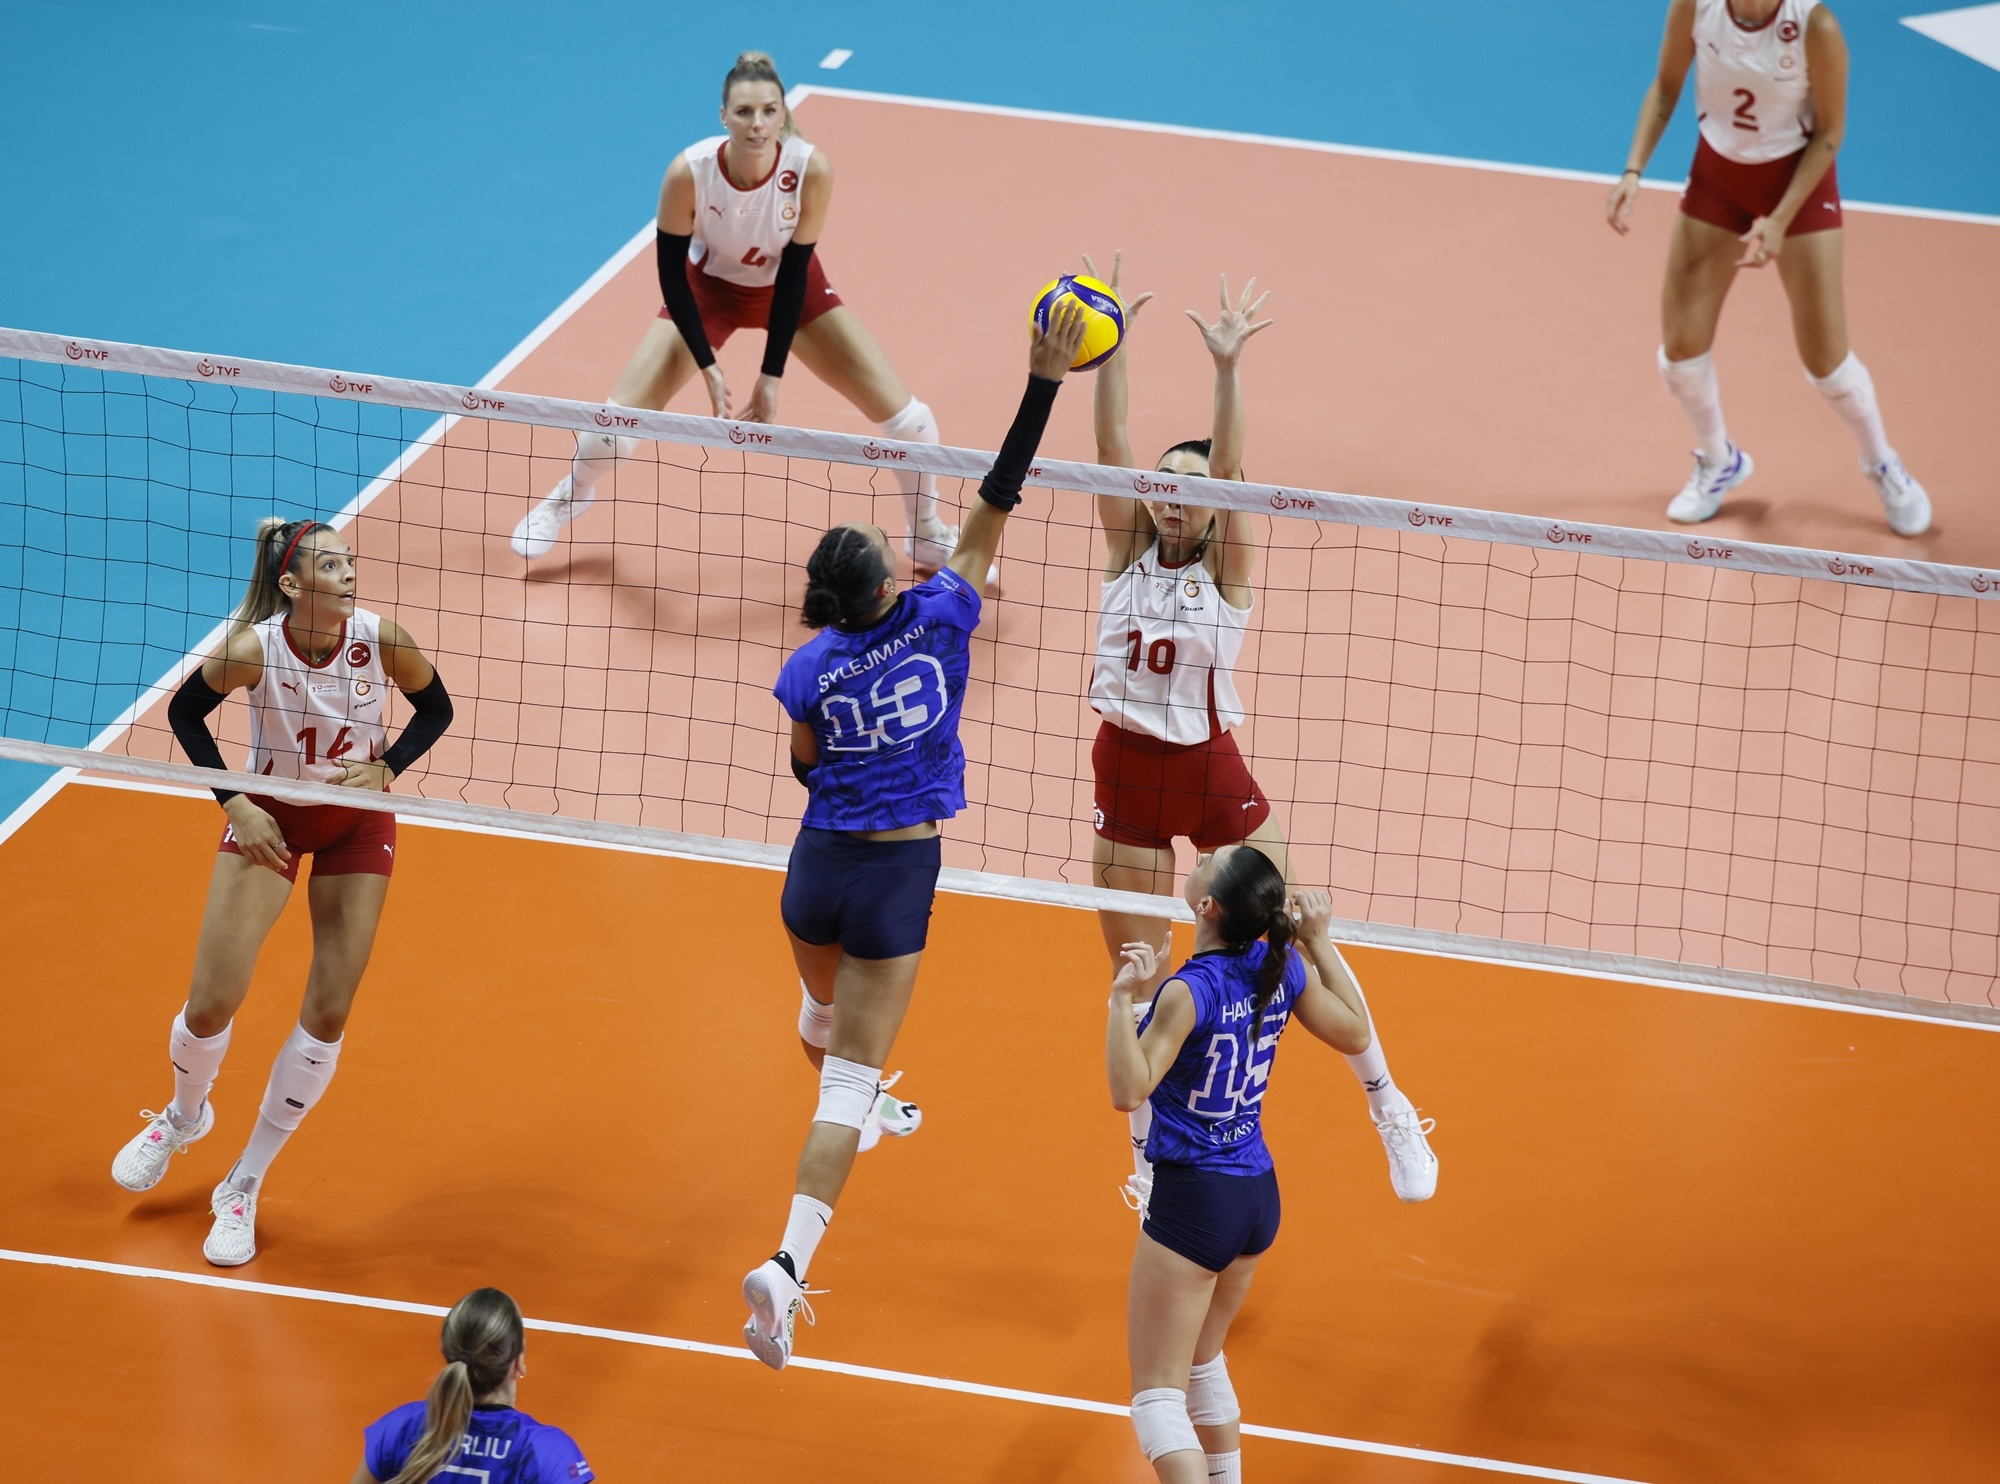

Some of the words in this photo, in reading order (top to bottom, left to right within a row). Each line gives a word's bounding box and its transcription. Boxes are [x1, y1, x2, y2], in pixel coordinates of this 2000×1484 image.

[1733, 88, 1756, 121] 2
[740, 247, 767, 267] 4
[85, 349, 109, 360] TVF
[217, 365, 240, 377] TVF
[348, 382, 372, 393] TVF
[481, 399, 505, 410] TVF
[614, 416, 638, 428] TVF
[748, 433, 772, 444] TVF
[882, 449, 907, 460] TVF
[1026, 468, 1042, 478] VF
[1153, 482, 1178, 494] TVF
[1290, 499, 1315, 510] TVF
[1428, 515, 1453, 527] TVF
[1567, 532, 1592, 543] TVF
[1707, 547, 1733, 559] TVF
[1848, 564, 1874, 576] TVF
[1127, 630, 1176, 674] 10
[817, 625, 925, 693] SYLEJMANI
[821, 653, 947, 752] 13
[296, 727, 353, 765] 14
